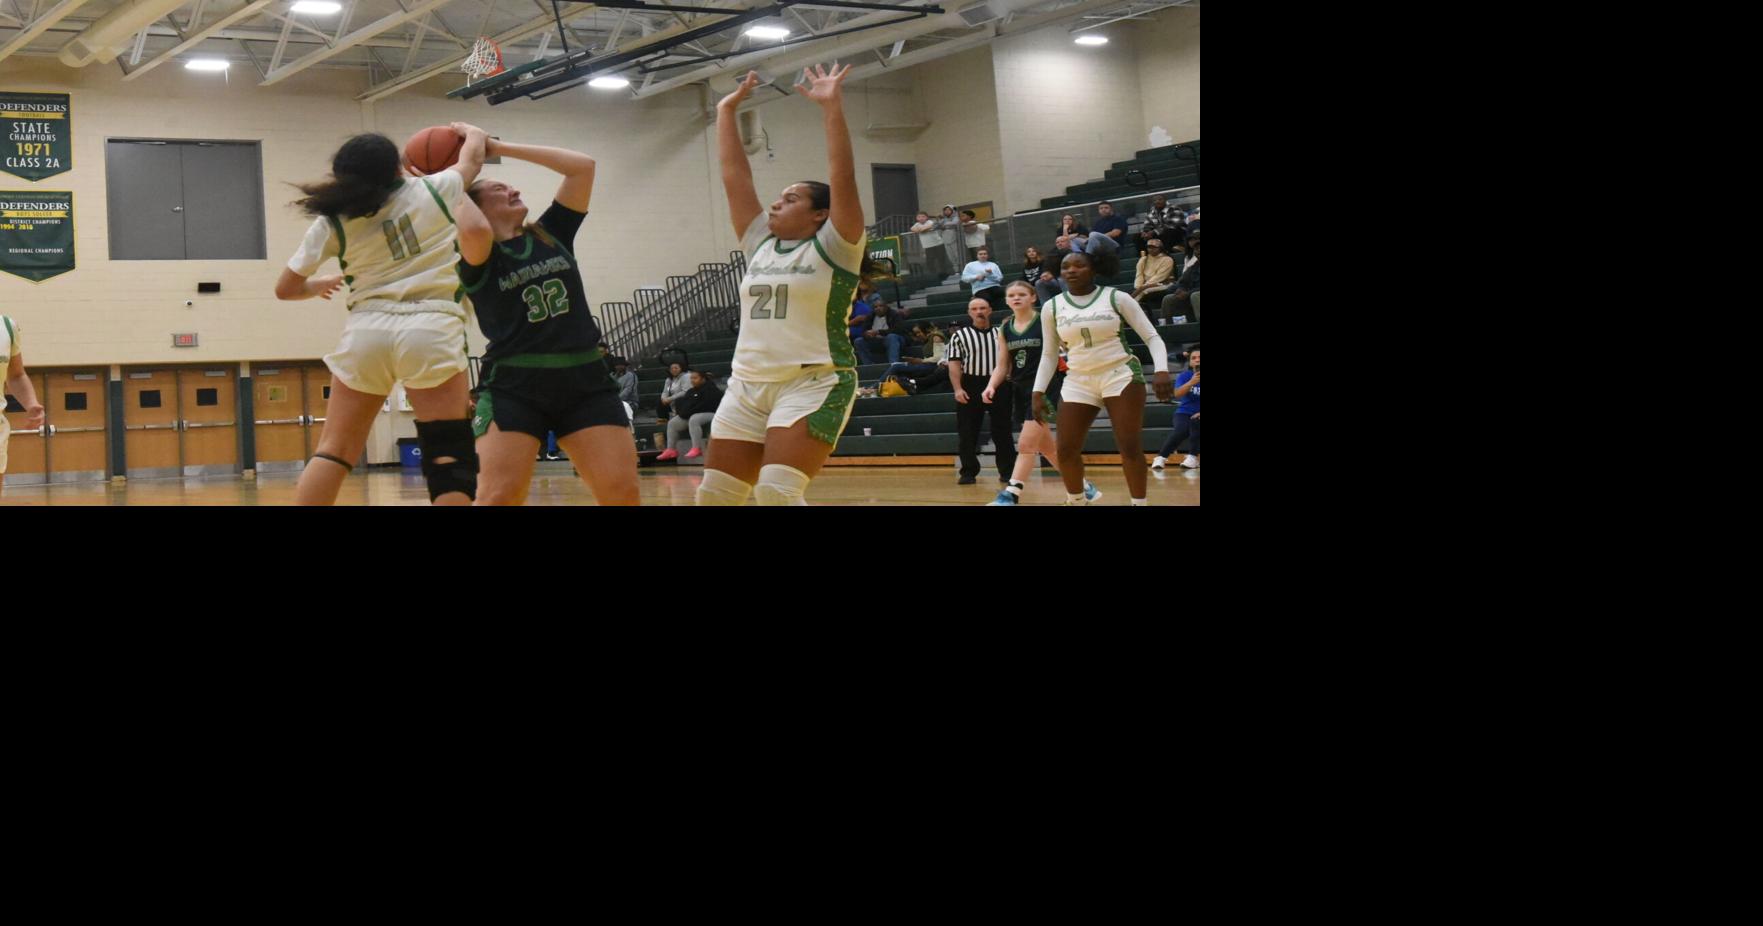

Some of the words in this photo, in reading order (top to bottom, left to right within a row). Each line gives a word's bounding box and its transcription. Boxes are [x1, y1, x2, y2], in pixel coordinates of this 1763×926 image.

[0, 103, 67, 112] DEFENDERS
[13, 122, 51, 134] STATE
[9, 133, 56, 142] CHAMPIONS
[16, 142, 51, 156] 1971
[6, 157, 40, 168] CLASS
[45, 158, 60, 168] 2A
[0, 201, 70, 210] DEFENDERS
[382, 212, 421, 261] 11
[521, 278, 569, 323] 32
[749, 283, 788, 320] 21
[1080, 327, 1093, 348] 1
